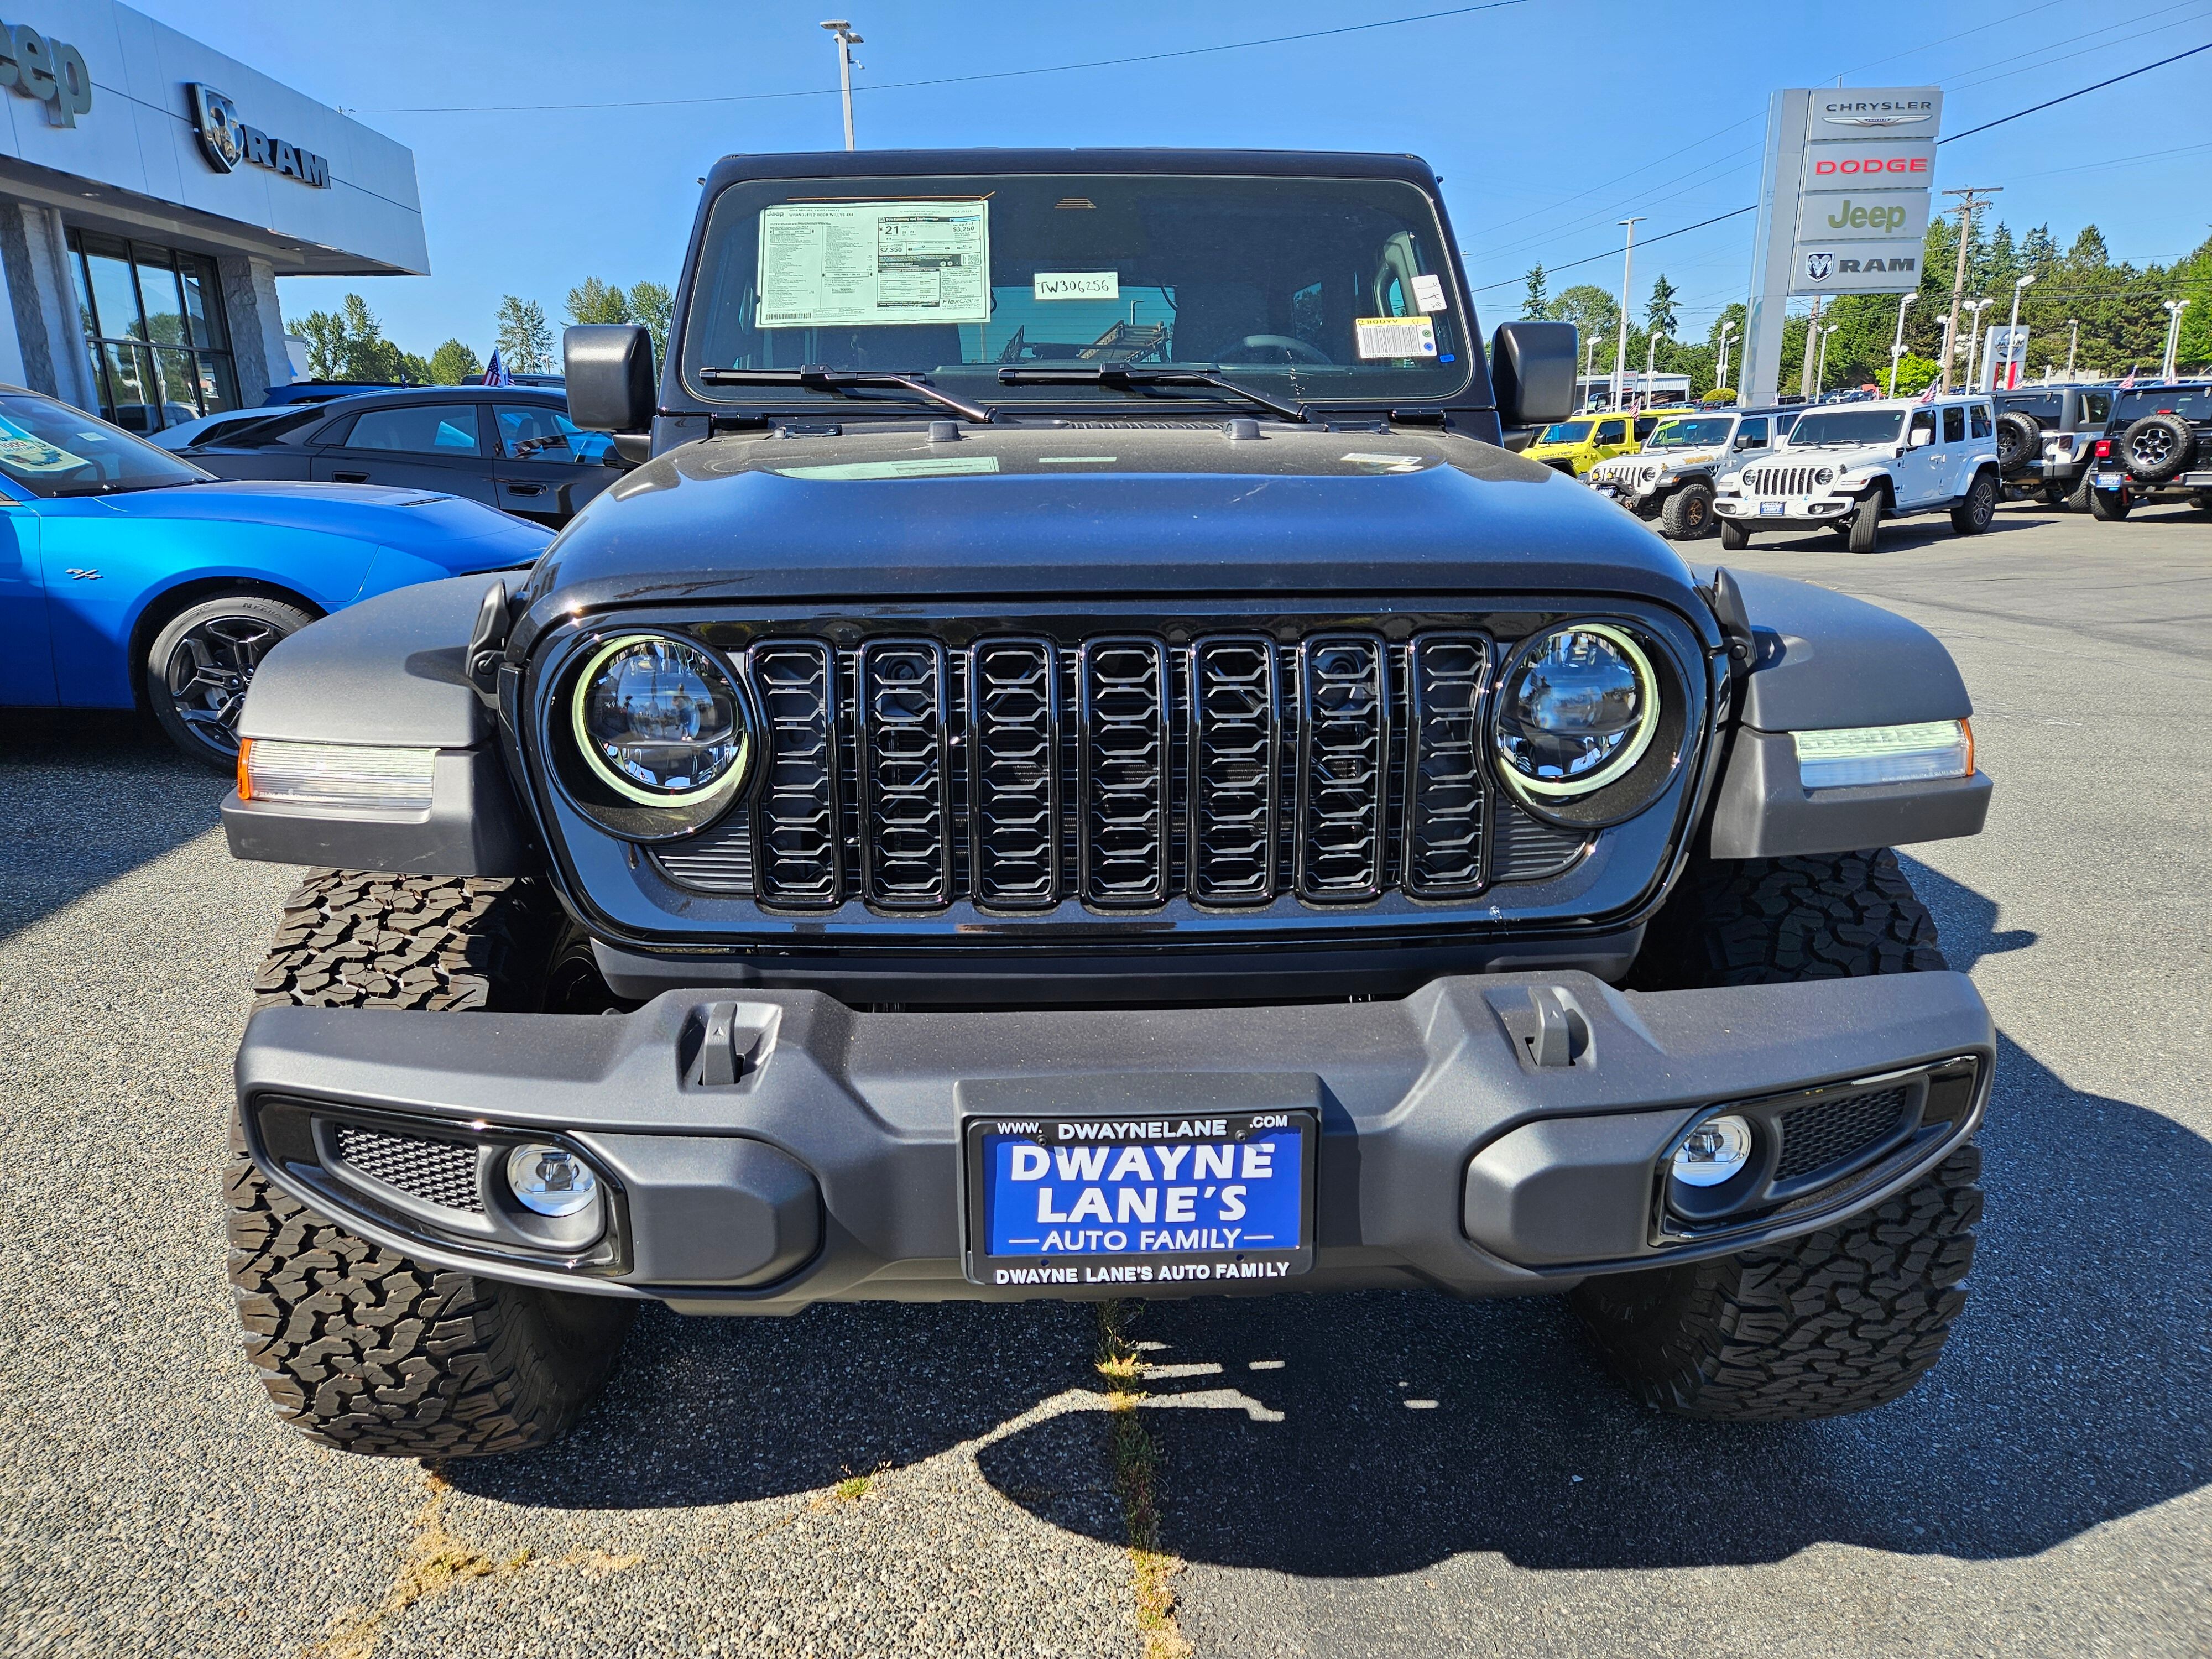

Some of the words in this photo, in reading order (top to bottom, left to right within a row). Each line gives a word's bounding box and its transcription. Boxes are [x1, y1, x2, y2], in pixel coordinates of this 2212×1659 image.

[1825, 101, 1932, 111] CHRYSLER
[239, 124, 331, 189] RAM
[1815, 158, 1929, 175] DODGE
[1828, 200, 1906, 233] Jeep
[885, 226, 899, 235] 21
[1839, 258, 1915, 273] RAM
[1036, 280, 1109, 293] TW306256
[997, 1122, 1042, 1134] WWW.
[1058, 1119, 1227, 1140] DWAYNELANE
[1250, 1115, 1288, 1128] .COM
[1011, 1143, 1275, 1181] DWAYNE
[1037, 1185, 1247, 1223] LANE'S
[1041, 1230, 1128, 1251] AUTO
[1140, 1228, 1242, 1251] FAMILY
[996, 1268, 1078, 1285] DWAYNE
[1086, 1266, 1154, 1282] LANE'S
[1158, 1265, 1211, 1281] AUTO
[1215, 1261, 1290, 1279] FAMILY
